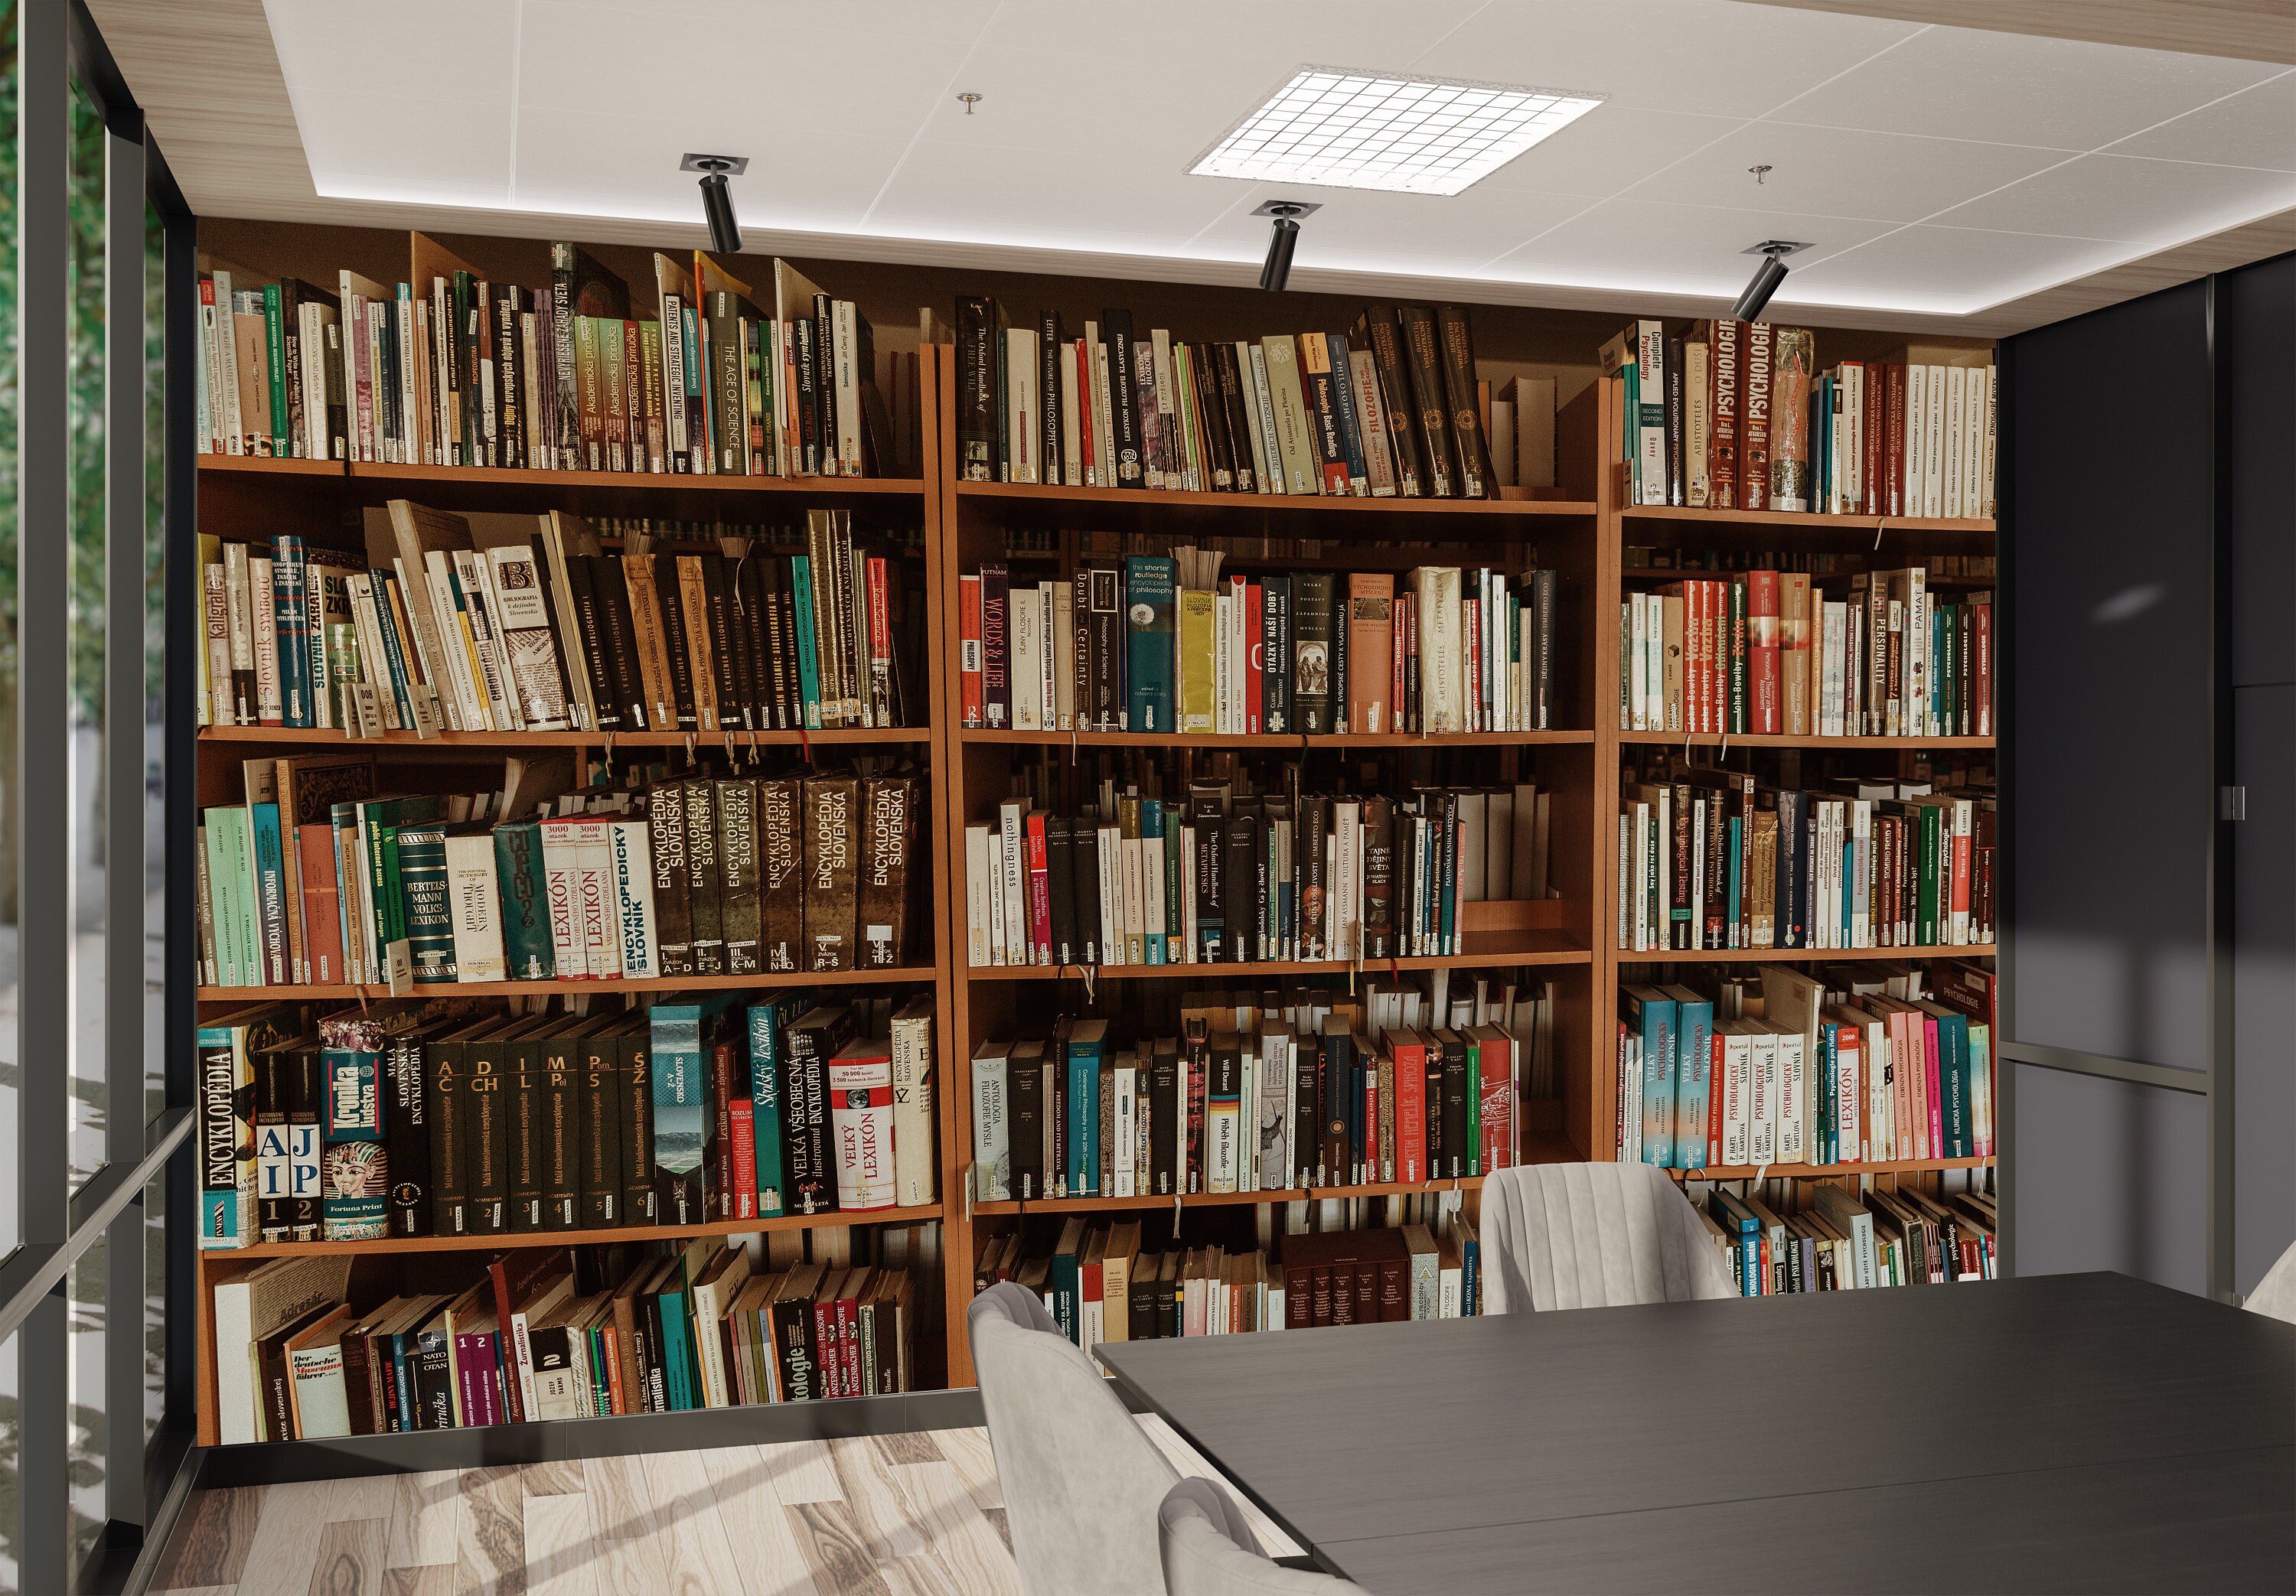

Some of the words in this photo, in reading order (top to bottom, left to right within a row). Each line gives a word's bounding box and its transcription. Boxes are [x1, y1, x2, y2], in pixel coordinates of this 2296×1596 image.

[554, 283, 568, 304] SVETA
[498, 300, 512, 329] vynálezů
[555, 305, 569, 332] ZÁHADY
[667, 301, 678, 329] PATENTS
[500, 337, 513, 360] objevů
[607, 327, 618, 360] príručka
[669, 331, 679, 345] AND
[725, 346, 735, 363] THE
[1117, 334, 1126, 373] KLASYCZNEJ
[1652, 331, 1660, 369] Complete
[556, 334, 571, 380] NEVYRIEŠENÉ
[670, 347, 680, 381] STRATEGIC
[1640, 335, 1650, 380] Psychology
[1717, 320, 1736, 416] PSYCHOLOGIE
[1749, 322, 1770, 419] PSYCHOLOGIE
[501, 363, 514, 402] evropských
[608, 363, 621, 415] Akademická
[726, 366, 736, 386] AGE
[672, 384, 683, 419] INVENTING
[727, 390, 737, 403] OF
[1317, 378, 1331, 414] Philosophy
[1362, 380, 1378, 433] FILOZOFIE
[504, 405, 515, 425] Dějiny
[728, 406, 739, 448] SCIENCE
[1047, 393, 1055, 446] PHILOSOPHY
[1324, 415, 1334, 431] Basic
[1326, 432, 1337, 458] Readings
[1077, 574, 1087, 609] Doubt
[1267, 590, 1277, 614] DOBY
[986, 598, 1003, 646] WORDS
[1265, 617, 1277, 637] NAŠÍ
[1732, 620, 1744, 656] Ztráta
[987, 649, 1003, 662] &
[1077, 629, 1087, 686] Certainty
[1265, 640, 1277, 673] OTÁZKY
[1876, 619, 1884, 686] PERSONALITY
[483, 643, 499, 702] CHRONOLÓGIA
[987, 665, 1003, 688] LIFE
[360, 690, 373, 699] 008
[652, 790, 671, 888] ENCYKLOPÉDIA
[667, 789, 684, 867] SLOVENSKA
[686, 789, 703, 887] ENCYKLOPÉDIA
[700, 789, 714, 865] SLOVENSKA
[728, 790, 739, 887] ENCYKLOPÉDIA
[739, 789, 751, 865] SLOVENSKA
[768, 792, 780, 888] ENCYKLOPÉDIA
[780, 791, 791, 867] SLOVENSKA
[818, 792, 832, 889] ENCYKLOPÉDIA
[832, 792, 846, 868] SLOVENSKA
[874, 790, 890, 886] ENCYKLOPÉDIA
[889, 790, 903, 865] SLOVENSKA
[1677, 817, 1689, 871] Psychological
[372, 841, 380, 867] internet
[1005, 817, 1016, 887] nothingness
[265, 870, 276, 923] INFORMAČNÁ
[407, 881, 447, 892] BERTELS-
[413, 894, 441, 903] MANN
[613, 826, 635, 971] ENCYKLOPEDICKÝ
[1676, 872, 1688, 903] Testing
[410, 914, 448, 924] LEXIKON
[413, 904, 445, 914] VOLKS-
[550, 871, 571, 947] LEXIKÓN
[581, 870, 602, 946] LEXIKÓN
[633, 901, 647, 970] SLOVNÍK
[752, 1018, 771, 1060] lexikón
[396, 1047, 408, 1107] SLOVENSKÁ
[439, 1061, 453, 1075] A
[478, 1061, 491, 1074] D
[547, 1057, 565, 1070] M
[590, 1073, 599, 1087] S
[1404, 1055, 1418, 1093] SPINOZA
[333, 1066, 360, 1129] Kronika
[410, 1047, 422, 1125] ENCYKLOPÉDIA
[439, 1076, 452, 1092] Č
[471, 1078, 497, 1092] CH
[520, 1076, 531, 1088] L
[755, 1064, 778, 1108] Školský
[785, 1057, 806, 1133] VŠEOBECNÁ
[804, 1057, 823, 1125] ENCYKLOPÉDIA
[982, 1081, 991, 1119] FILOZOFIE
[1841, 1067, 1853, 1132] LEXIKÓN
[204, 1053, 234, 1186] ENCYKLOPÉDIA
[983, 1120, 992, 1147] MYSLE
[258, 1129, 288, 1157] A
[293, 1129, 315, 1156] J
[789, 1135, 807, 1179] VEĽKÁ
[811, 1128, 823, 1177] ilustrovaná
[841, 1124, 856, 1169] VEĽKÝ
[859, 1112, 878, 1179] LEXIKÓN
[1221, 1141, 1229, 1168] filozofie
[266, 1166, 280, 1194] I
[294, 1165, 318, 1193] P
[267, 1200, 279, 1220] 1
[298, 1200, 311, 1219] 2
[1949, 1223, 1959, 1261] psychologie
[422, 1352, 446, 1360] NATO
[478, 1337, 485, 1347] 2
[294, 1357, 337, 1368] deutsche
[295, 1363, 343, 1374] Museums
[385, 1361, 394, 1383] MAFIE
[386, 1386, 396, 1409] DEJINY
